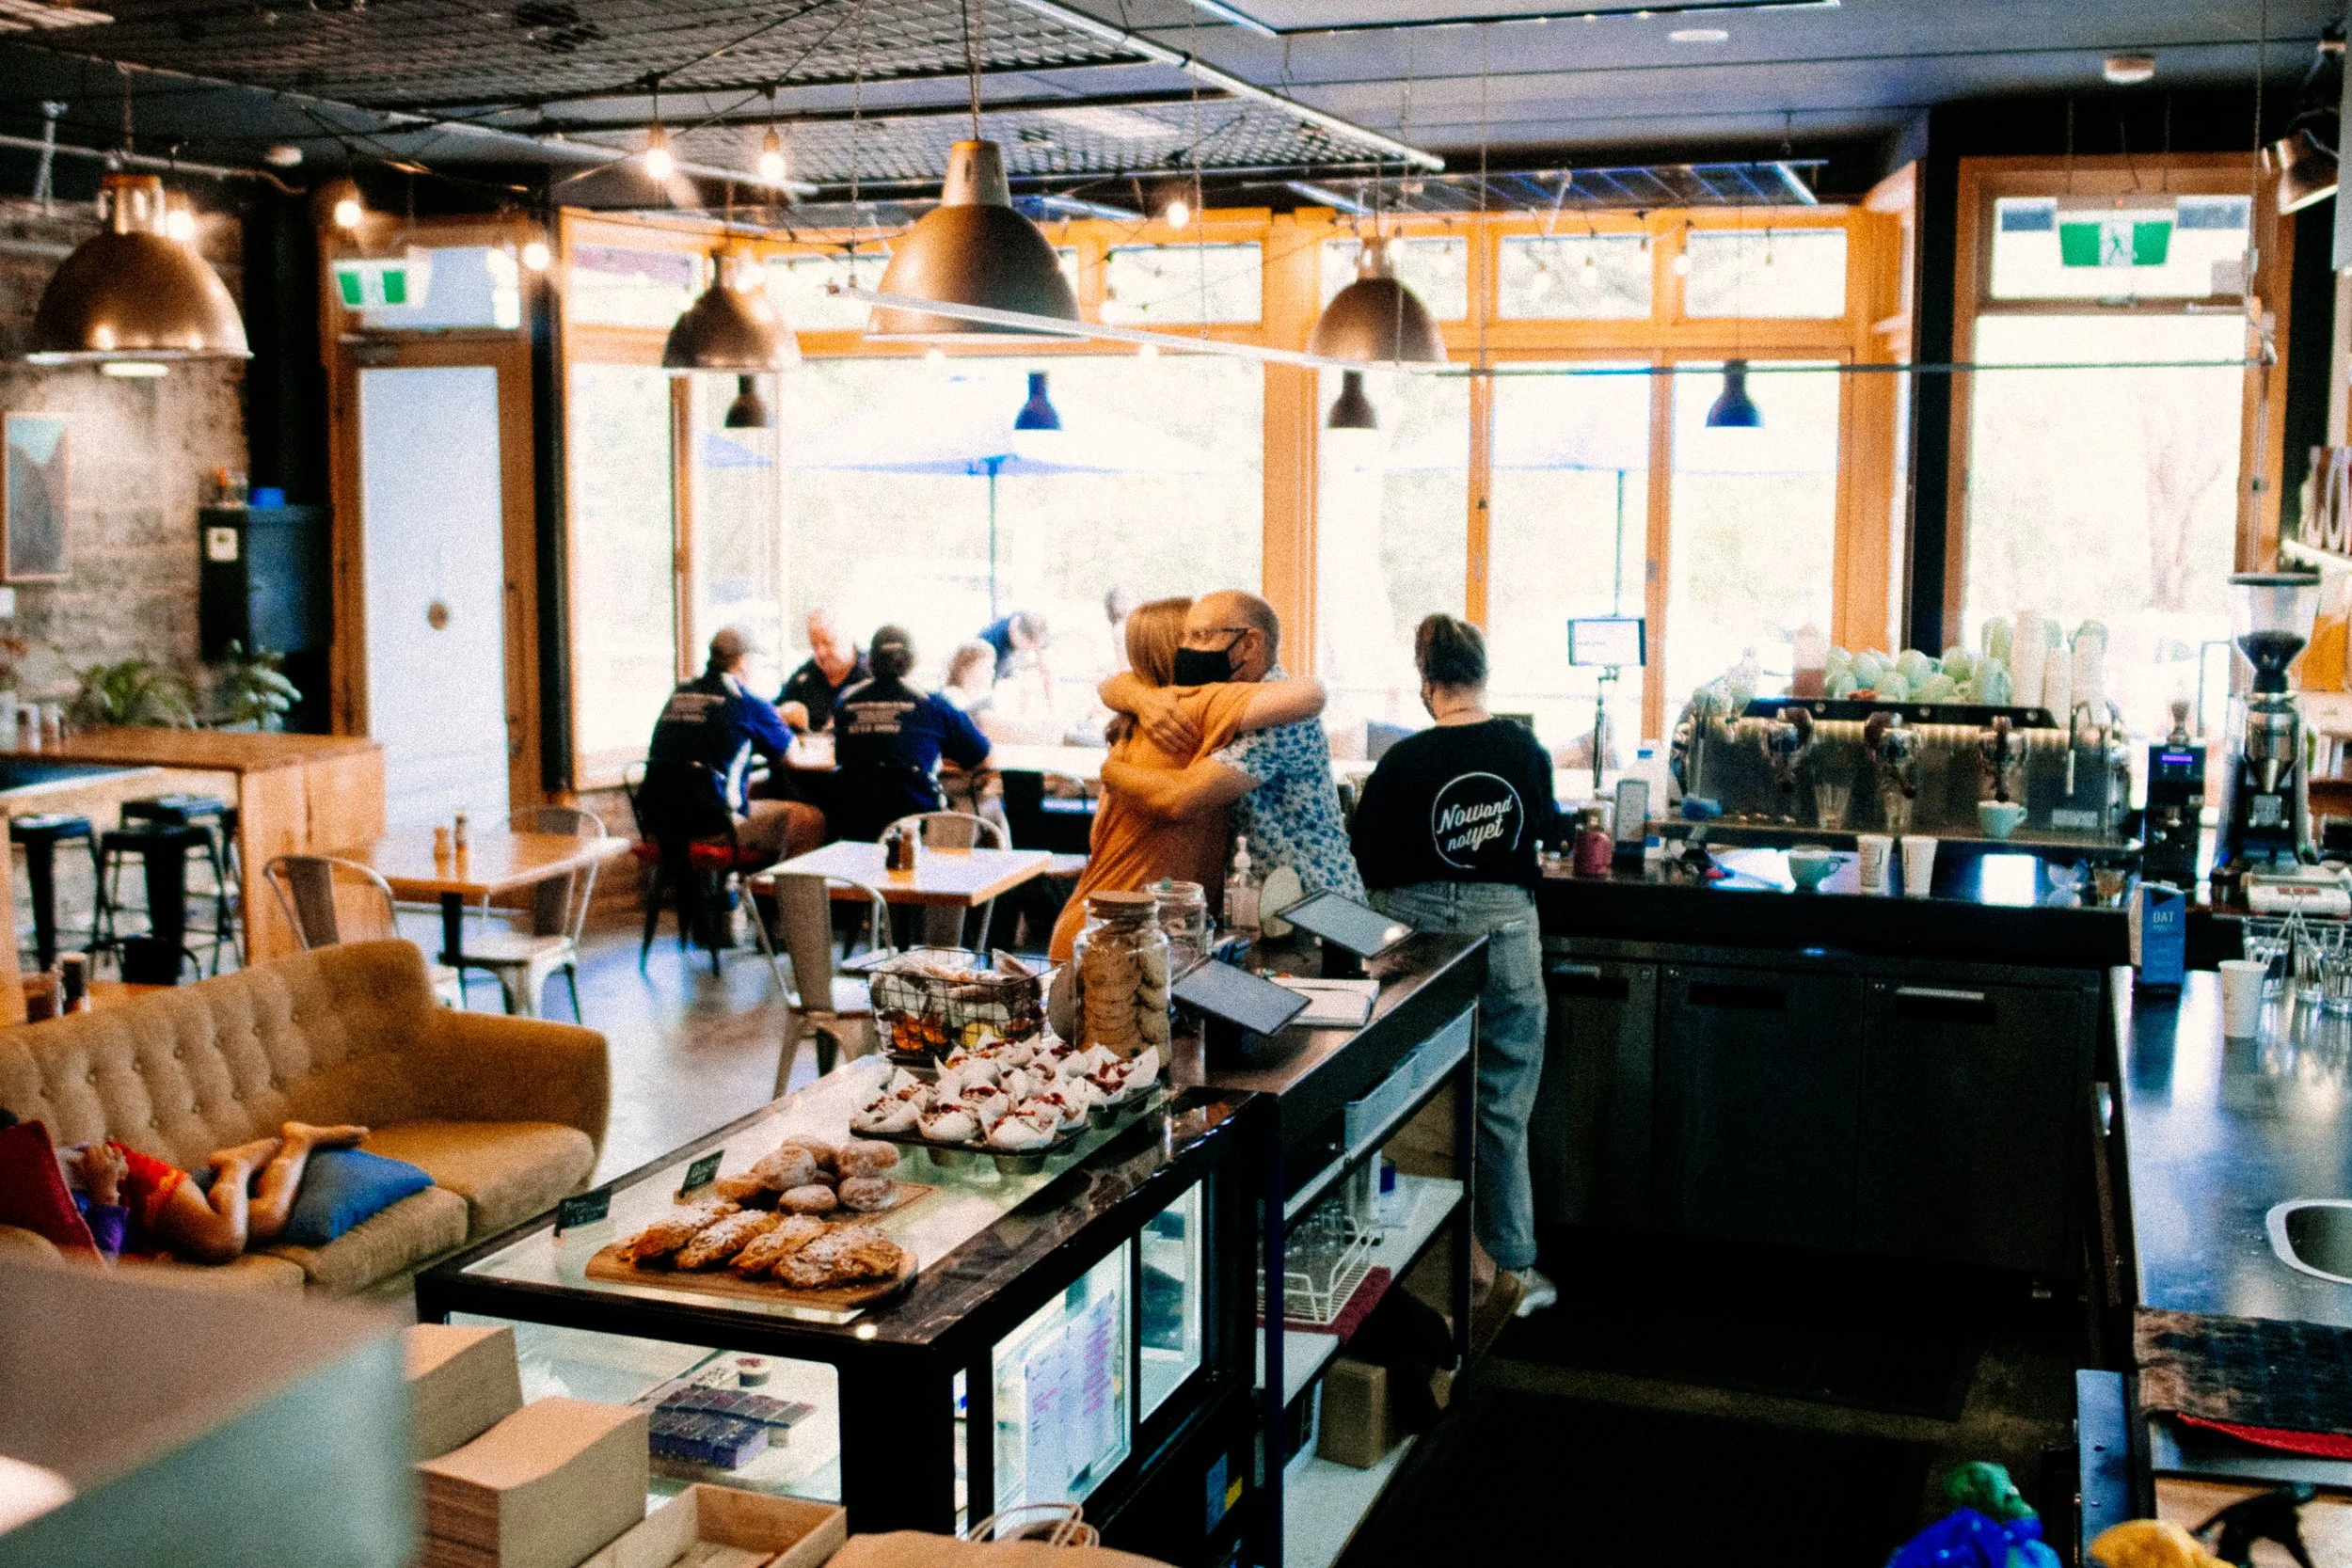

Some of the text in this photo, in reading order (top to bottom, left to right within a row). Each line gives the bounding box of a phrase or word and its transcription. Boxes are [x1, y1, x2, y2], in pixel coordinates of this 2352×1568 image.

[1437, 795, 1513, 834] Now and
[1470, 815, 1504, 851] yet
